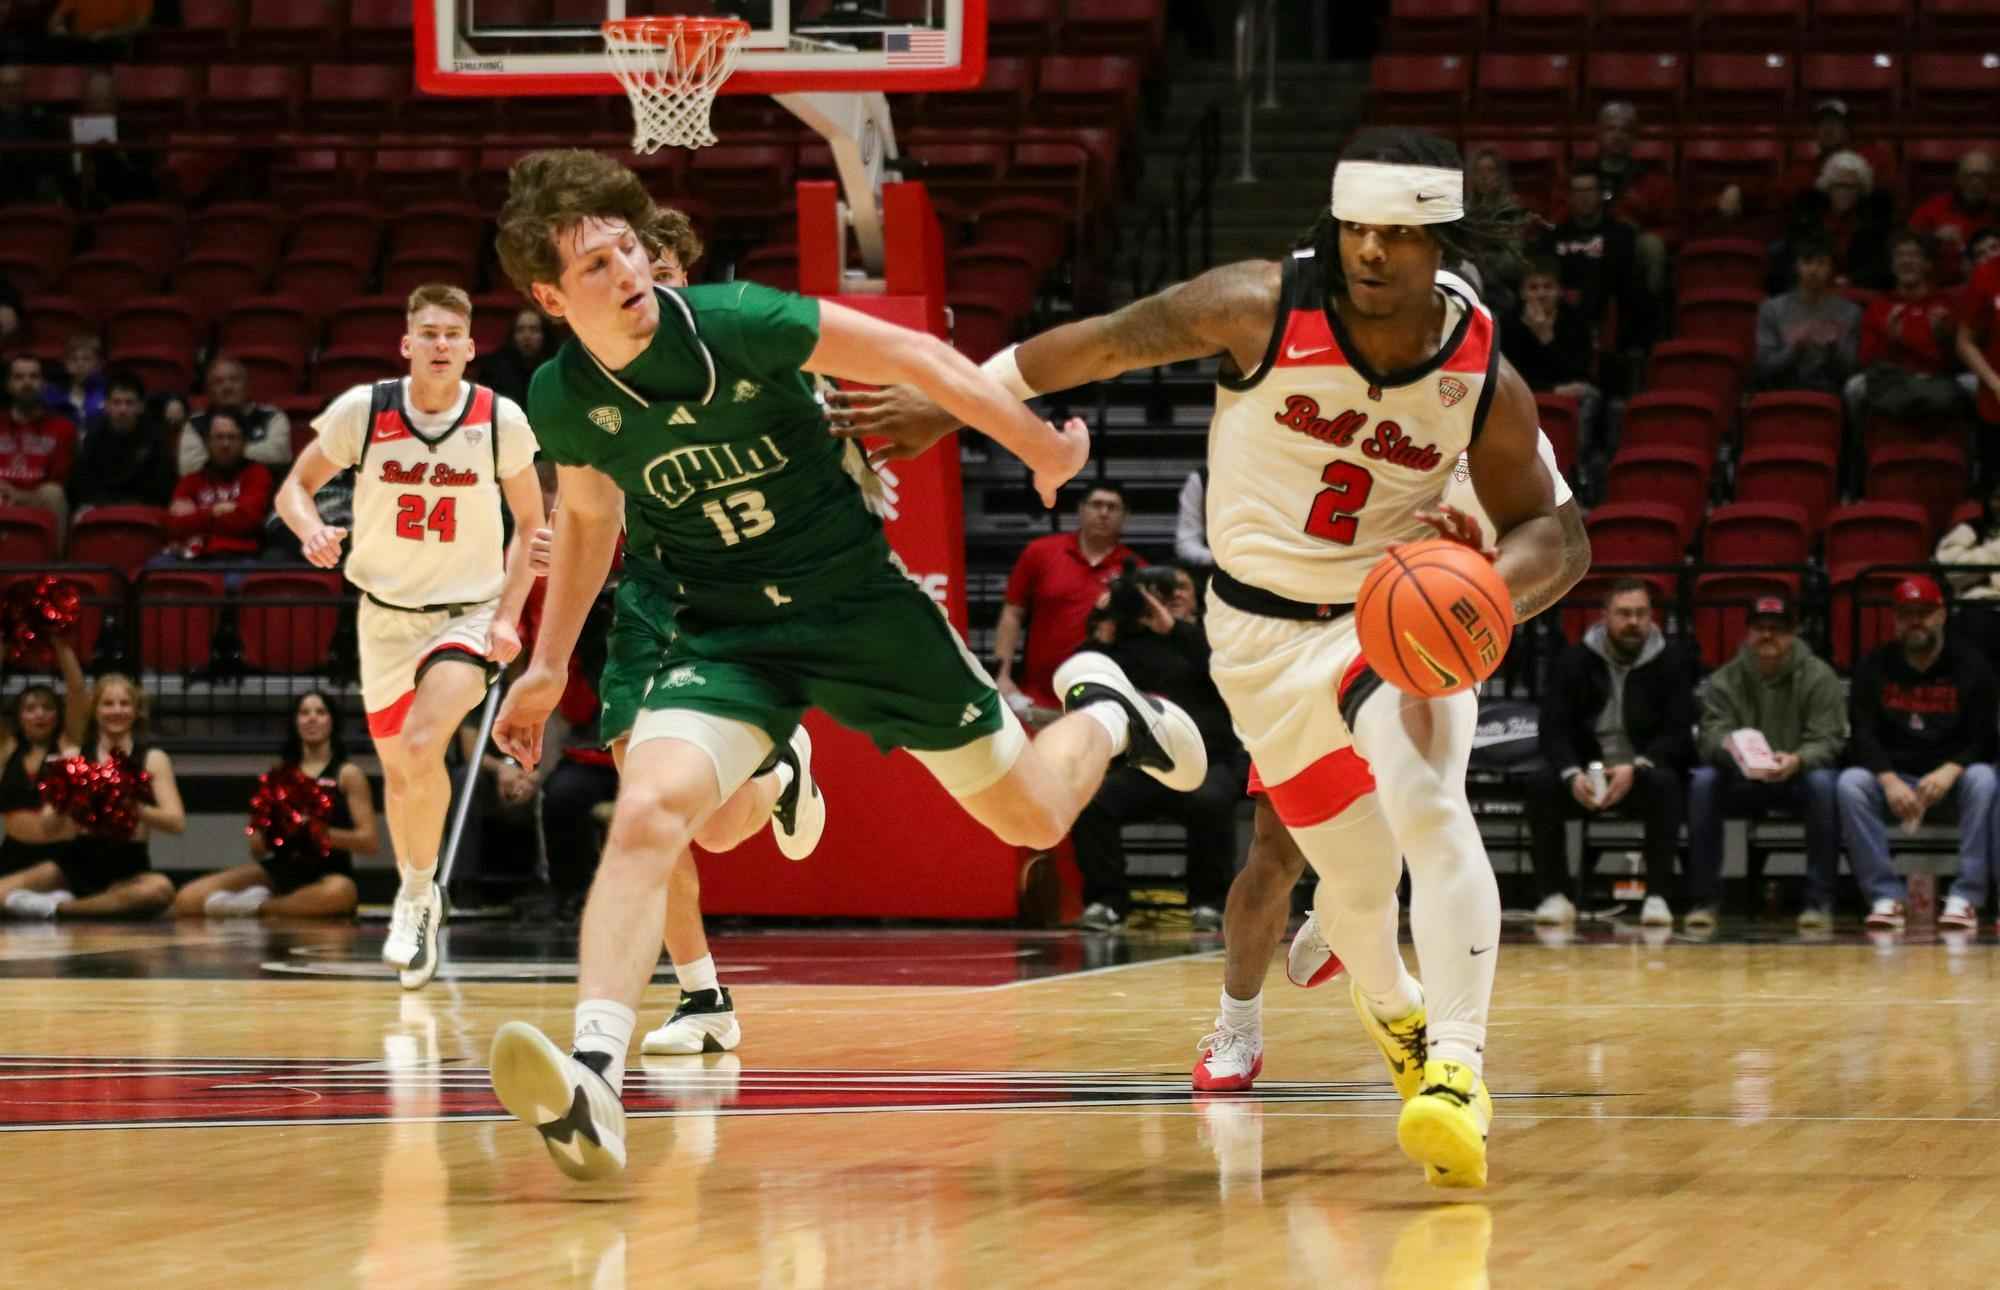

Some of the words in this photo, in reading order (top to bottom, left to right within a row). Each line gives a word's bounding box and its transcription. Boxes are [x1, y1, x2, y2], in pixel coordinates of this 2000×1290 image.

[1274, 394, 1368, 448] Ball
[1361, 420, 1443, 471] State
[379, 460, 429, 485] Ball
[429, 463, 479, 487] State
[1304, 459, 1374, 546] 2
[396, 493, 456, 542] 24
[702, 490, 775, 546] 13
[1450, 596, 1498, 667] ELITE
